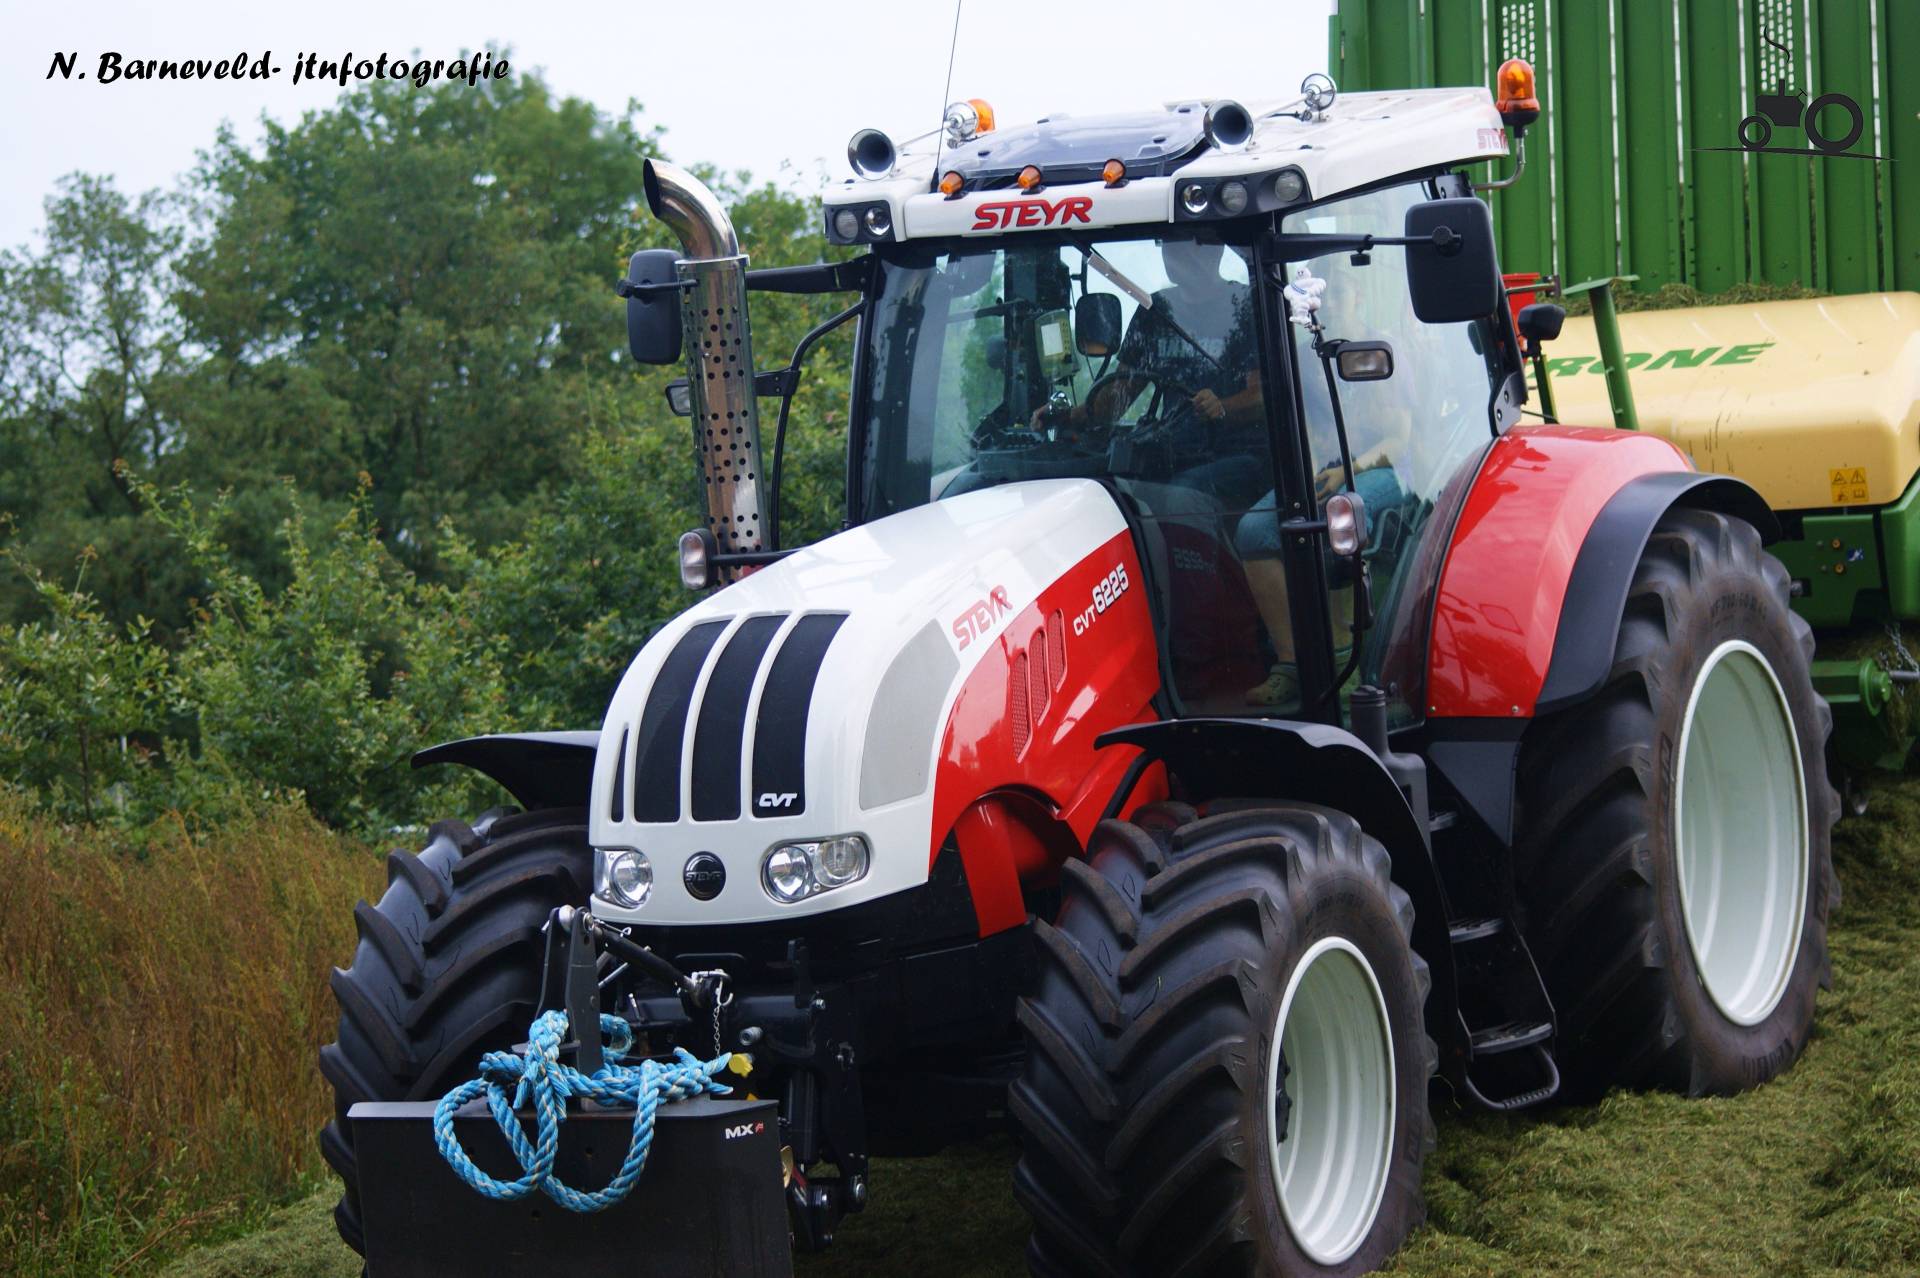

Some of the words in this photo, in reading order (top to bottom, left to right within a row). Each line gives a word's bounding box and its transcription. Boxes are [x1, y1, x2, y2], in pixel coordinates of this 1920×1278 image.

[971, 196, 1094, 231] STEYR
[1525, 342, 1777, 379] RONE
[952, 584, 1014, 652] STEYR
[1072, 606, 1097, 637] CVT
[1091, 562, 1130, 615] 6225
[758, 792, 798, 808] CVT
